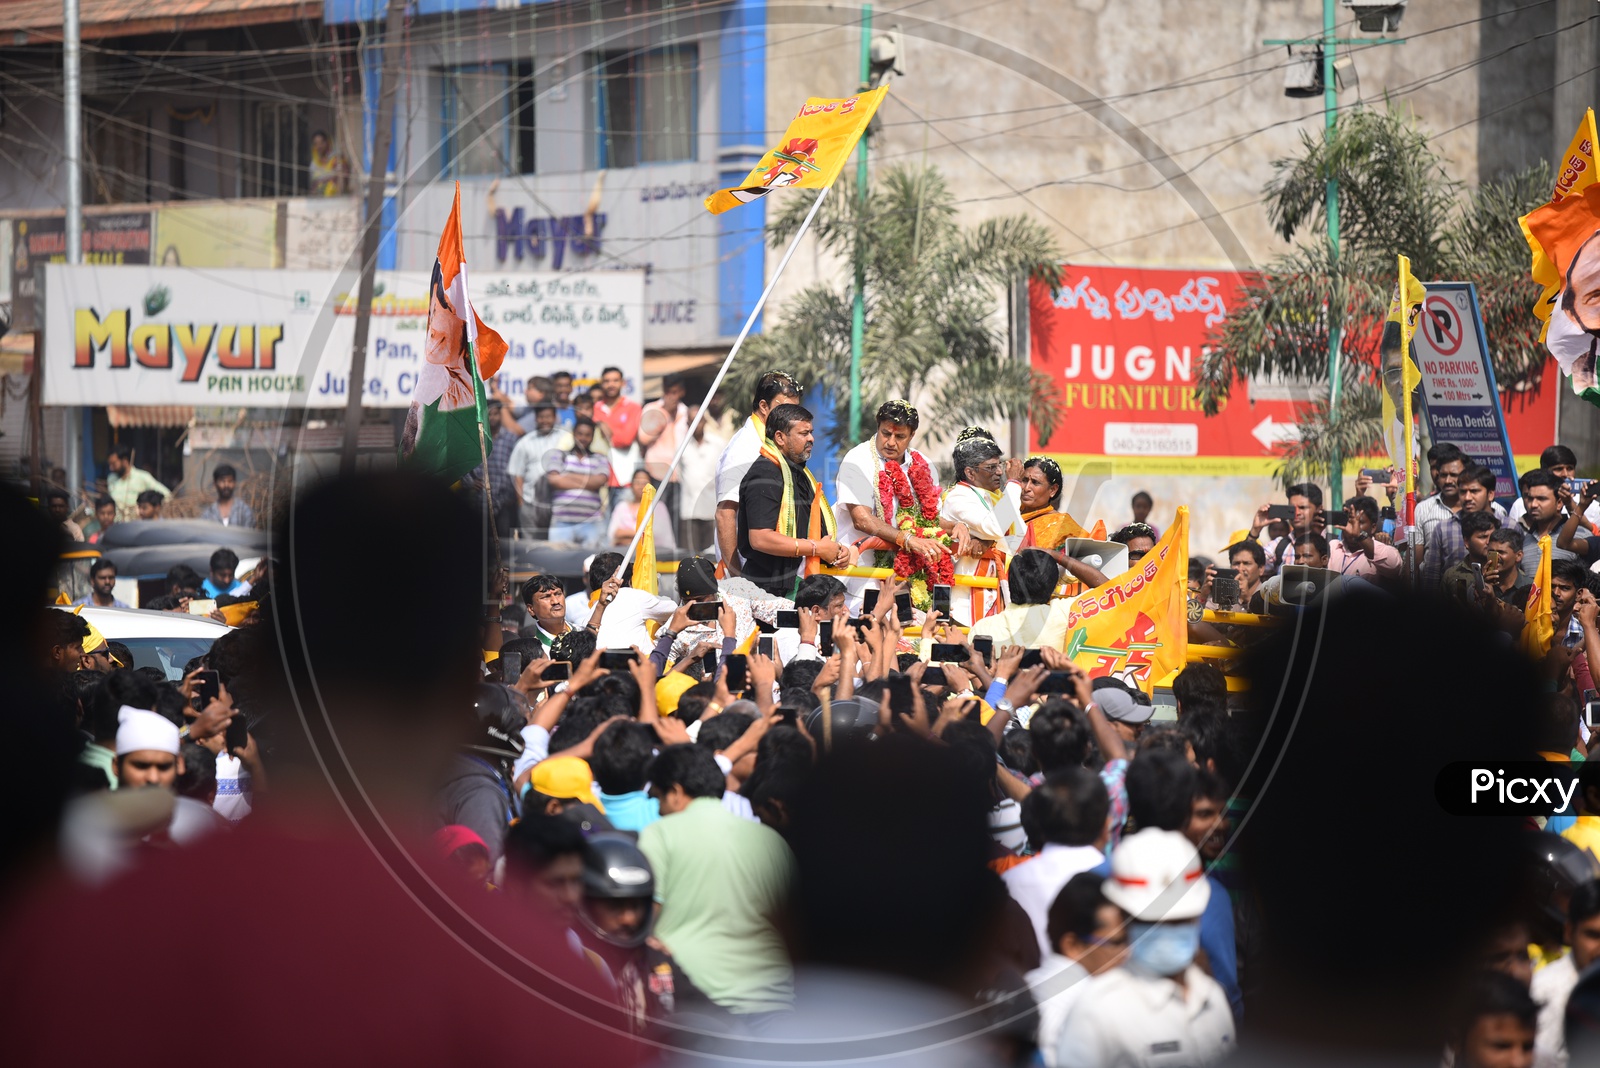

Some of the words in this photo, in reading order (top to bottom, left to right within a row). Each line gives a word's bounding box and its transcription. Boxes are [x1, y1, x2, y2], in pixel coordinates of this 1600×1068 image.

[649, 299, 696, 324] JUICE
[72, 307, 284, 383] Mayur
[375, 338, 417, 361] Pan,
[533, 339, 583, 362] Gola,
[1424, 361, 1437, 374] NO
[1438, 361, 1479, 375] PARKING
[207, 375, 243, 392] PAN
[247, 375, 305, 393] HOUSE
[1432, 378, 1447, 388] FINE
[1448, 378, 1457, 388] Rs.
[1459, 378, 1477, 388] 1000/-
[1443, 390, 1456, 400] 100
[1457, 390, 1471, 401] Mtrs
[1432, 414, 1462, 428] Partha
[1464, 414, 1496, 428] Dental
[1464, 443, 1479, 452] Clinic
[1480, 443, 1502, 453] Address
[1488, 457, 1504, 466] Fresh
